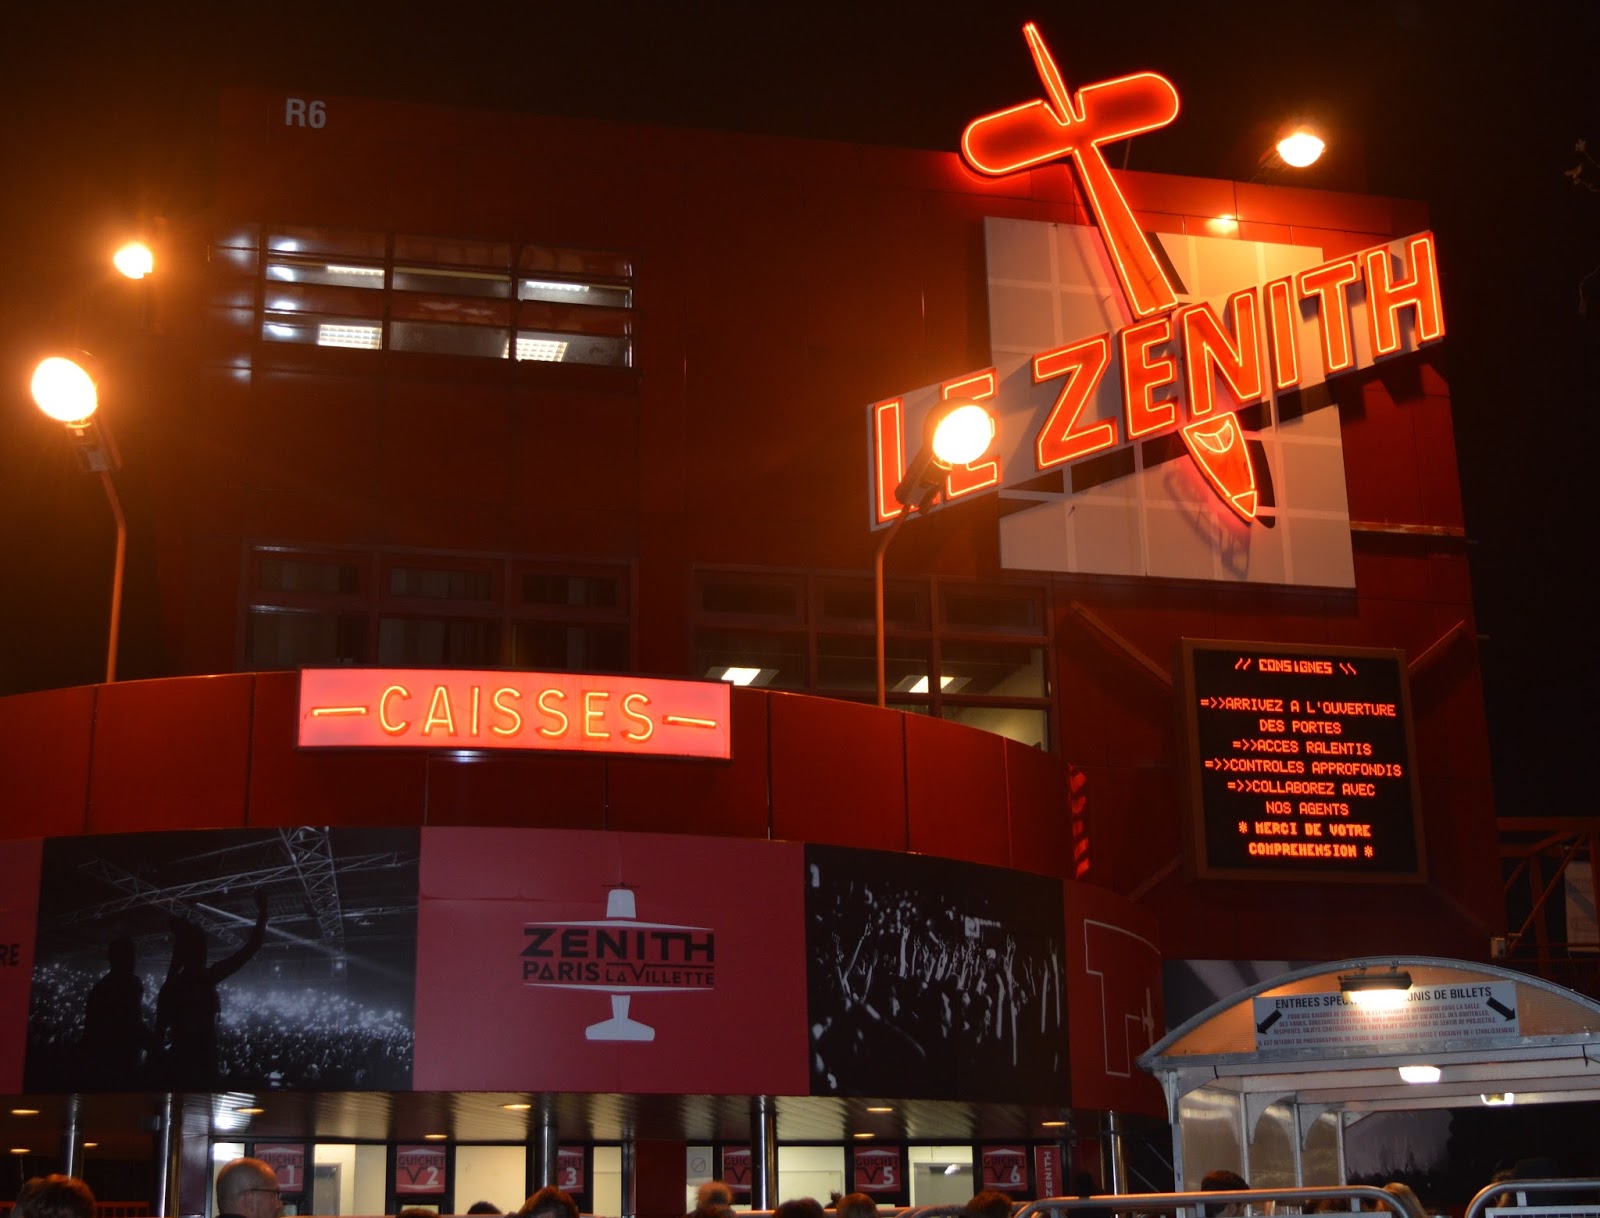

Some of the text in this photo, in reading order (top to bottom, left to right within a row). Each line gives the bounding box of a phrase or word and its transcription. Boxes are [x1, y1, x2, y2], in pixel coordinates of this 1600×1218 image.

[285, 97, 327, 129] R6
[1032, 229, 1446, 469] ZENITH
[1258, 658, 1333, 675] CONSIGNES
[377, 684, 656, 743] CAISSES
[1290, 699, 1300, 713] A
[1306, 700, 1396, 717] L'OUVERTURE
[1259, 718, 1342, 735] DES PORTES
[1305, 740, 1373, 756] RALENTIS
[1311, 761, 1402, 777] APPROFONDIS
[1341, 782, 1376, 797] AVEC
[1265, 800, 1350, 817] NOS AGENTS
[1254, 821, 1372, 838] MERCI DE VOTRE
[1248, 842, 1358, 858] COMPREHENSION
[520, 927, 715, 962] ZENITH
[523, 960, 600, 982] PARIS
[630, 963, 715, 985] VILLETTE
[1275, 996, 1320, 1009] ENTREES
[1434, 989, 1447, 1000] DE
[1450, 986, 1492, 999] BILLETS
[397, 1155, 445, 1166] GUICHET
[855, 1156, 900, 1167] GUICHET
[983, 1155, 1026, 1166] GUICHET
[286, 1164, 295, 1185] 1
[426, 1166, 439, 1185] 2
[565, 1167, 577, 1186] 3
[883, 1165, 895, 1185] 5
[1010, 1165, 1021, 1183] 6
[1043, 1150, 1054, 1197] ZENITH
